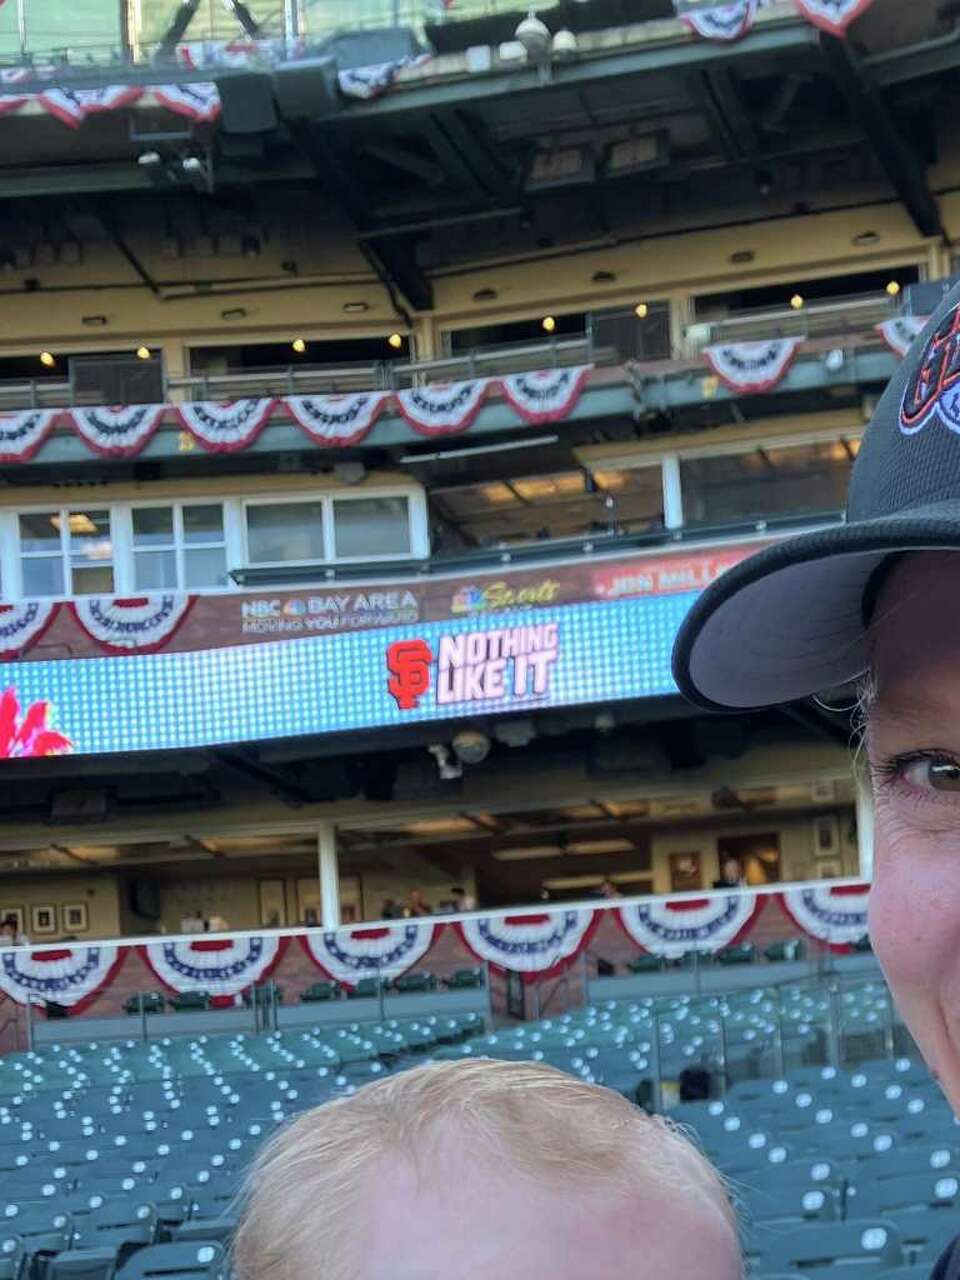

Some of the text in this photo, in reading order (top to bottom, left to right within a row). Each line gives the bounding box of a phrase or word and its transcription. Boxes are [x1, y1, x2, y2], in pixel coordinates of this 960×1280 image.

[241, 591, 418, 617] NBC BAY AREA
[439, 623, 558, 672] NOTHING
[437, 650, 558, 705] LIKE IT
